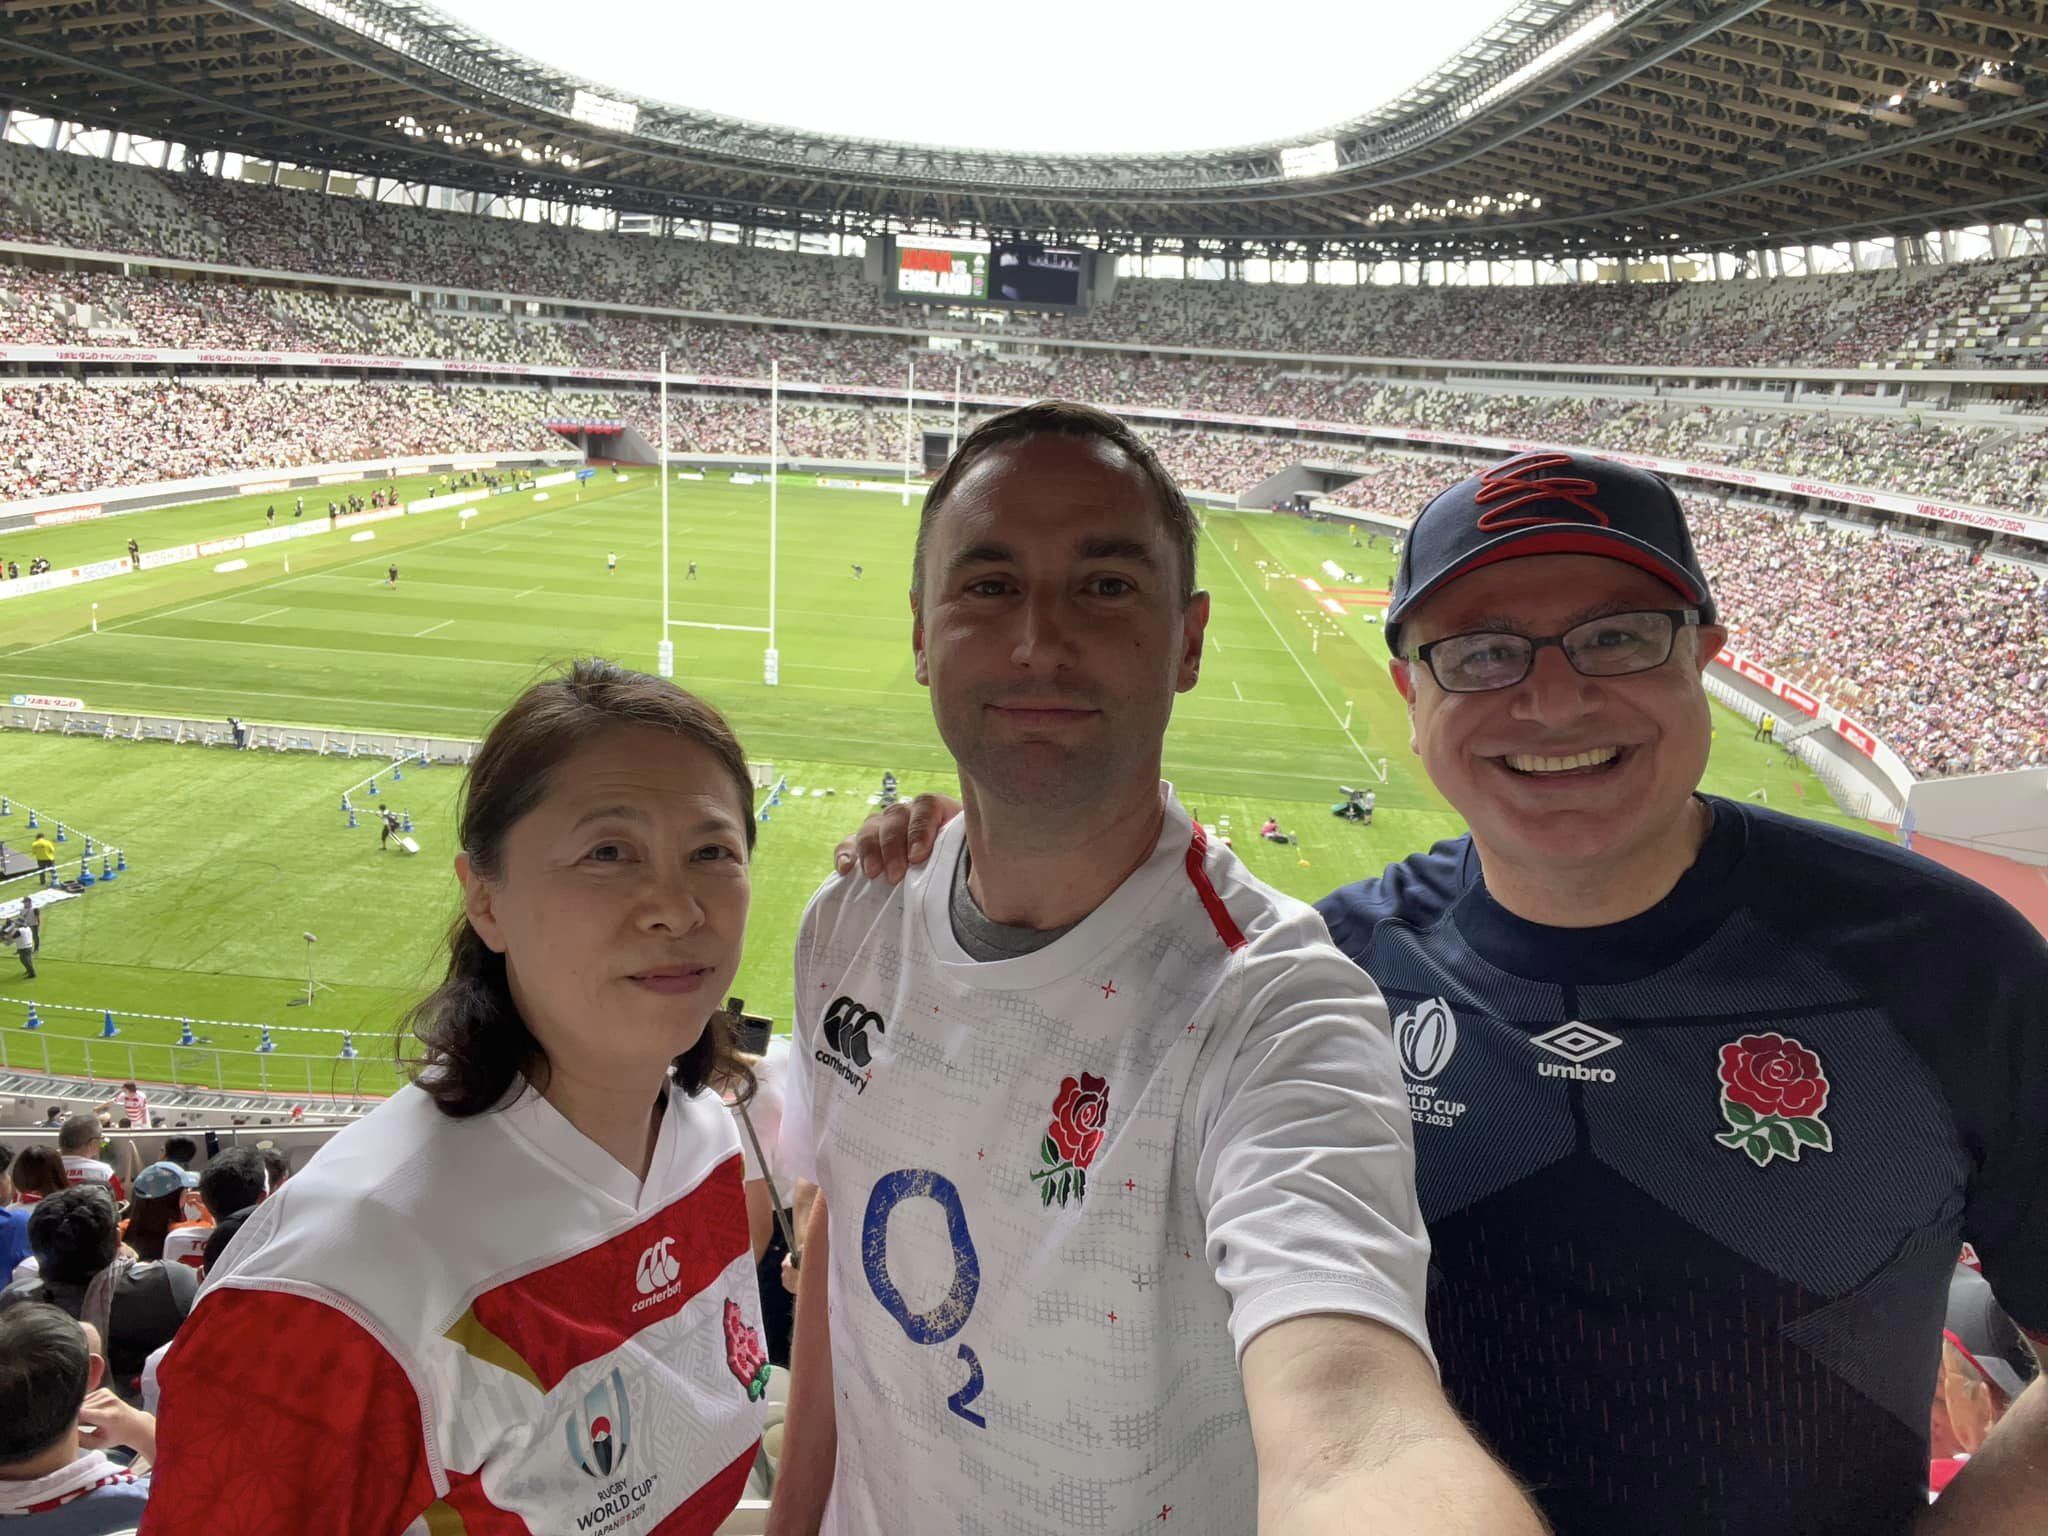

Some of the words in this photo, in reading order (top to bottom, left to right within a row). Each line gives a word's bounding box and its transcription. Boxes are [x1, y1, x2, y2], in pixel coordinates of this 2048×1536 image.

[815, 1050, 871, 1096] canterbury
[1537, 1062, 1617, 1083] umbro
[1406, 1084, 1438, 1097] UGBY
[1434, 1100, 1466, 1117] CUP
[1425, 1114, 1454, 1128] 2023
[597, 1478, 628, 1502] RUGBY
[576, 1494, 630, 1531] WORLD
